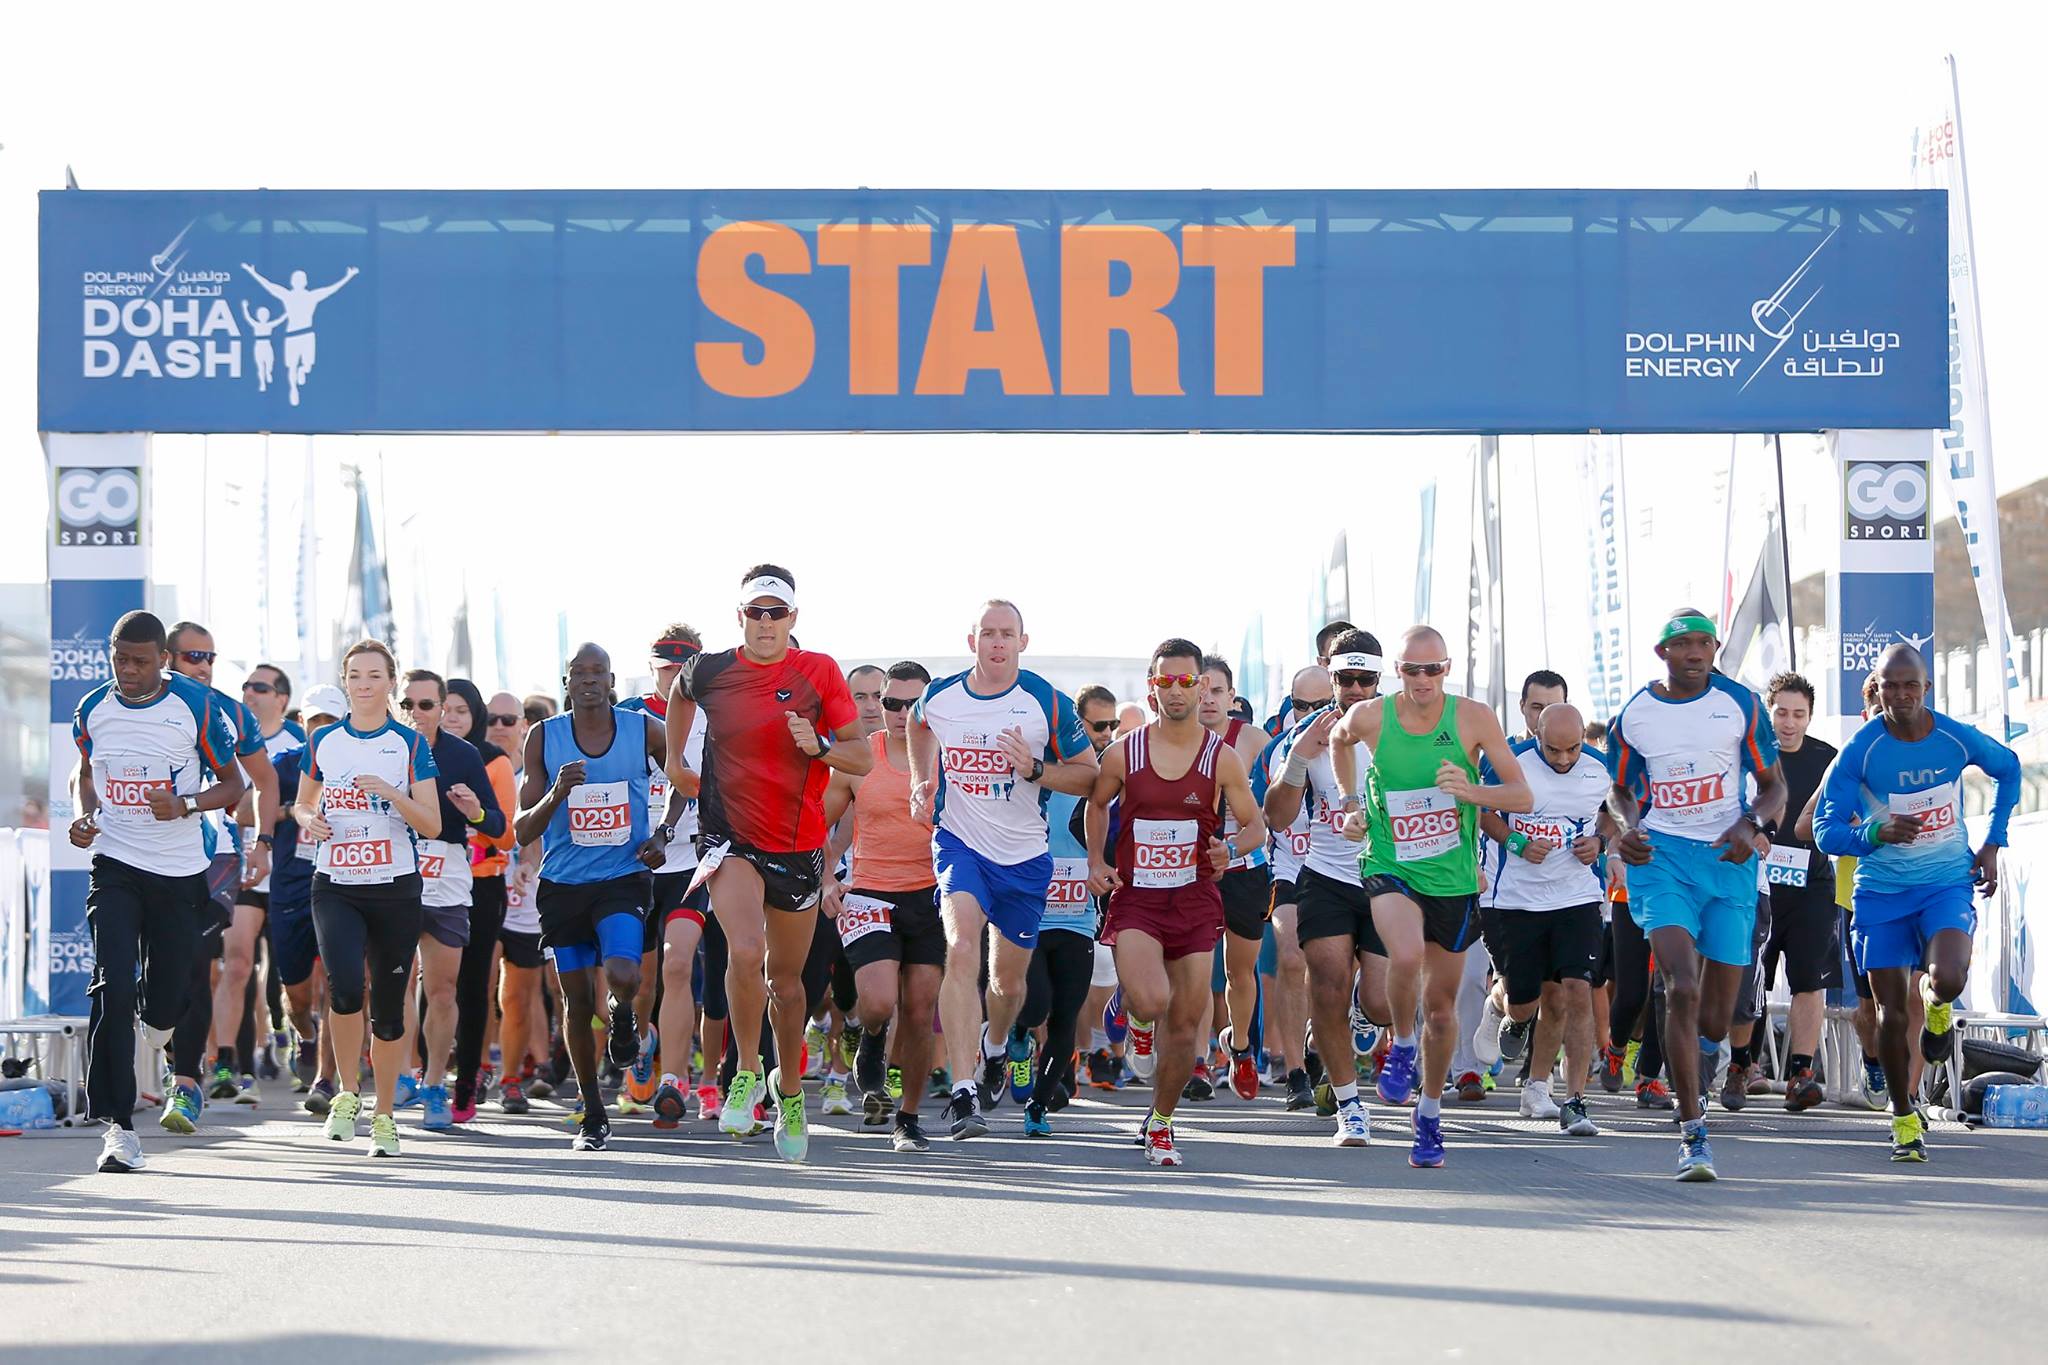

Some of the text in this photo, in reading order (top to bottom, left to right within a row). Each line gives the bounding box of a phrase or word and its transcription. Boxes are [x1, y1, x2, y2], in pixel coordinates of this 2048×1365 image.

[84, 271, 154, 283] DOLPHIN
[84, 285, 146, 296] ENERGY
[83, 299, 241, 337] DOHA
[694, 220, 1296, 398] START
[1625, 333, 1755, 353] DOLPHIN
[1803, 329, 1900, 353] دولفين
[83, 340, 241, 378] DASH
[1625, 358, 1742, 377] ENERGY
[1783, 356, 1884, 377] للطاقة
[59, 473, 139, 522] GO
[1847, 468, 1927, 515] GO
[61, 531, 138, 545] SPORT
[1849, 525, 1926, 538] SPORT
[50, 650, 110, 665] DOHA
[1843, 657, 1879, 671] DAS
[50, 665, 110, 680] DASH
[949, 749, 1008, 772] 0259
[1898, 768, 1935, 787] run
[324, 787, 368, 801] DOHA
[1657, 776, 1718, 807] 0377
[127, 807, 152, 816] 10KM
[571, 806, 626, 830] 0291
[1915, 806, 1952, 830] 49
[589, 831, 613, 839] 10KM
[1393, 811, 1457, 840] 0286
[1514, 819, 1562, 837] DOHA
[1414, 839, 1440, 850] 10KM
[1914, 832, 1936, 840] 0KM
[332, 842, 389, 866] 0661
[1136, 844, 1195, 868] 0537
[348, 868, 372, 876] 10KM
[419, 856, 442, 877] 74
[1152, 870, 1177, 879] 10KM
[1769, 867, 1806, 887] 843
[1046, 881, 1087, 901] 210
[50, 942, 95, 957] DOH
[50, 957, 94, 973] DAS
